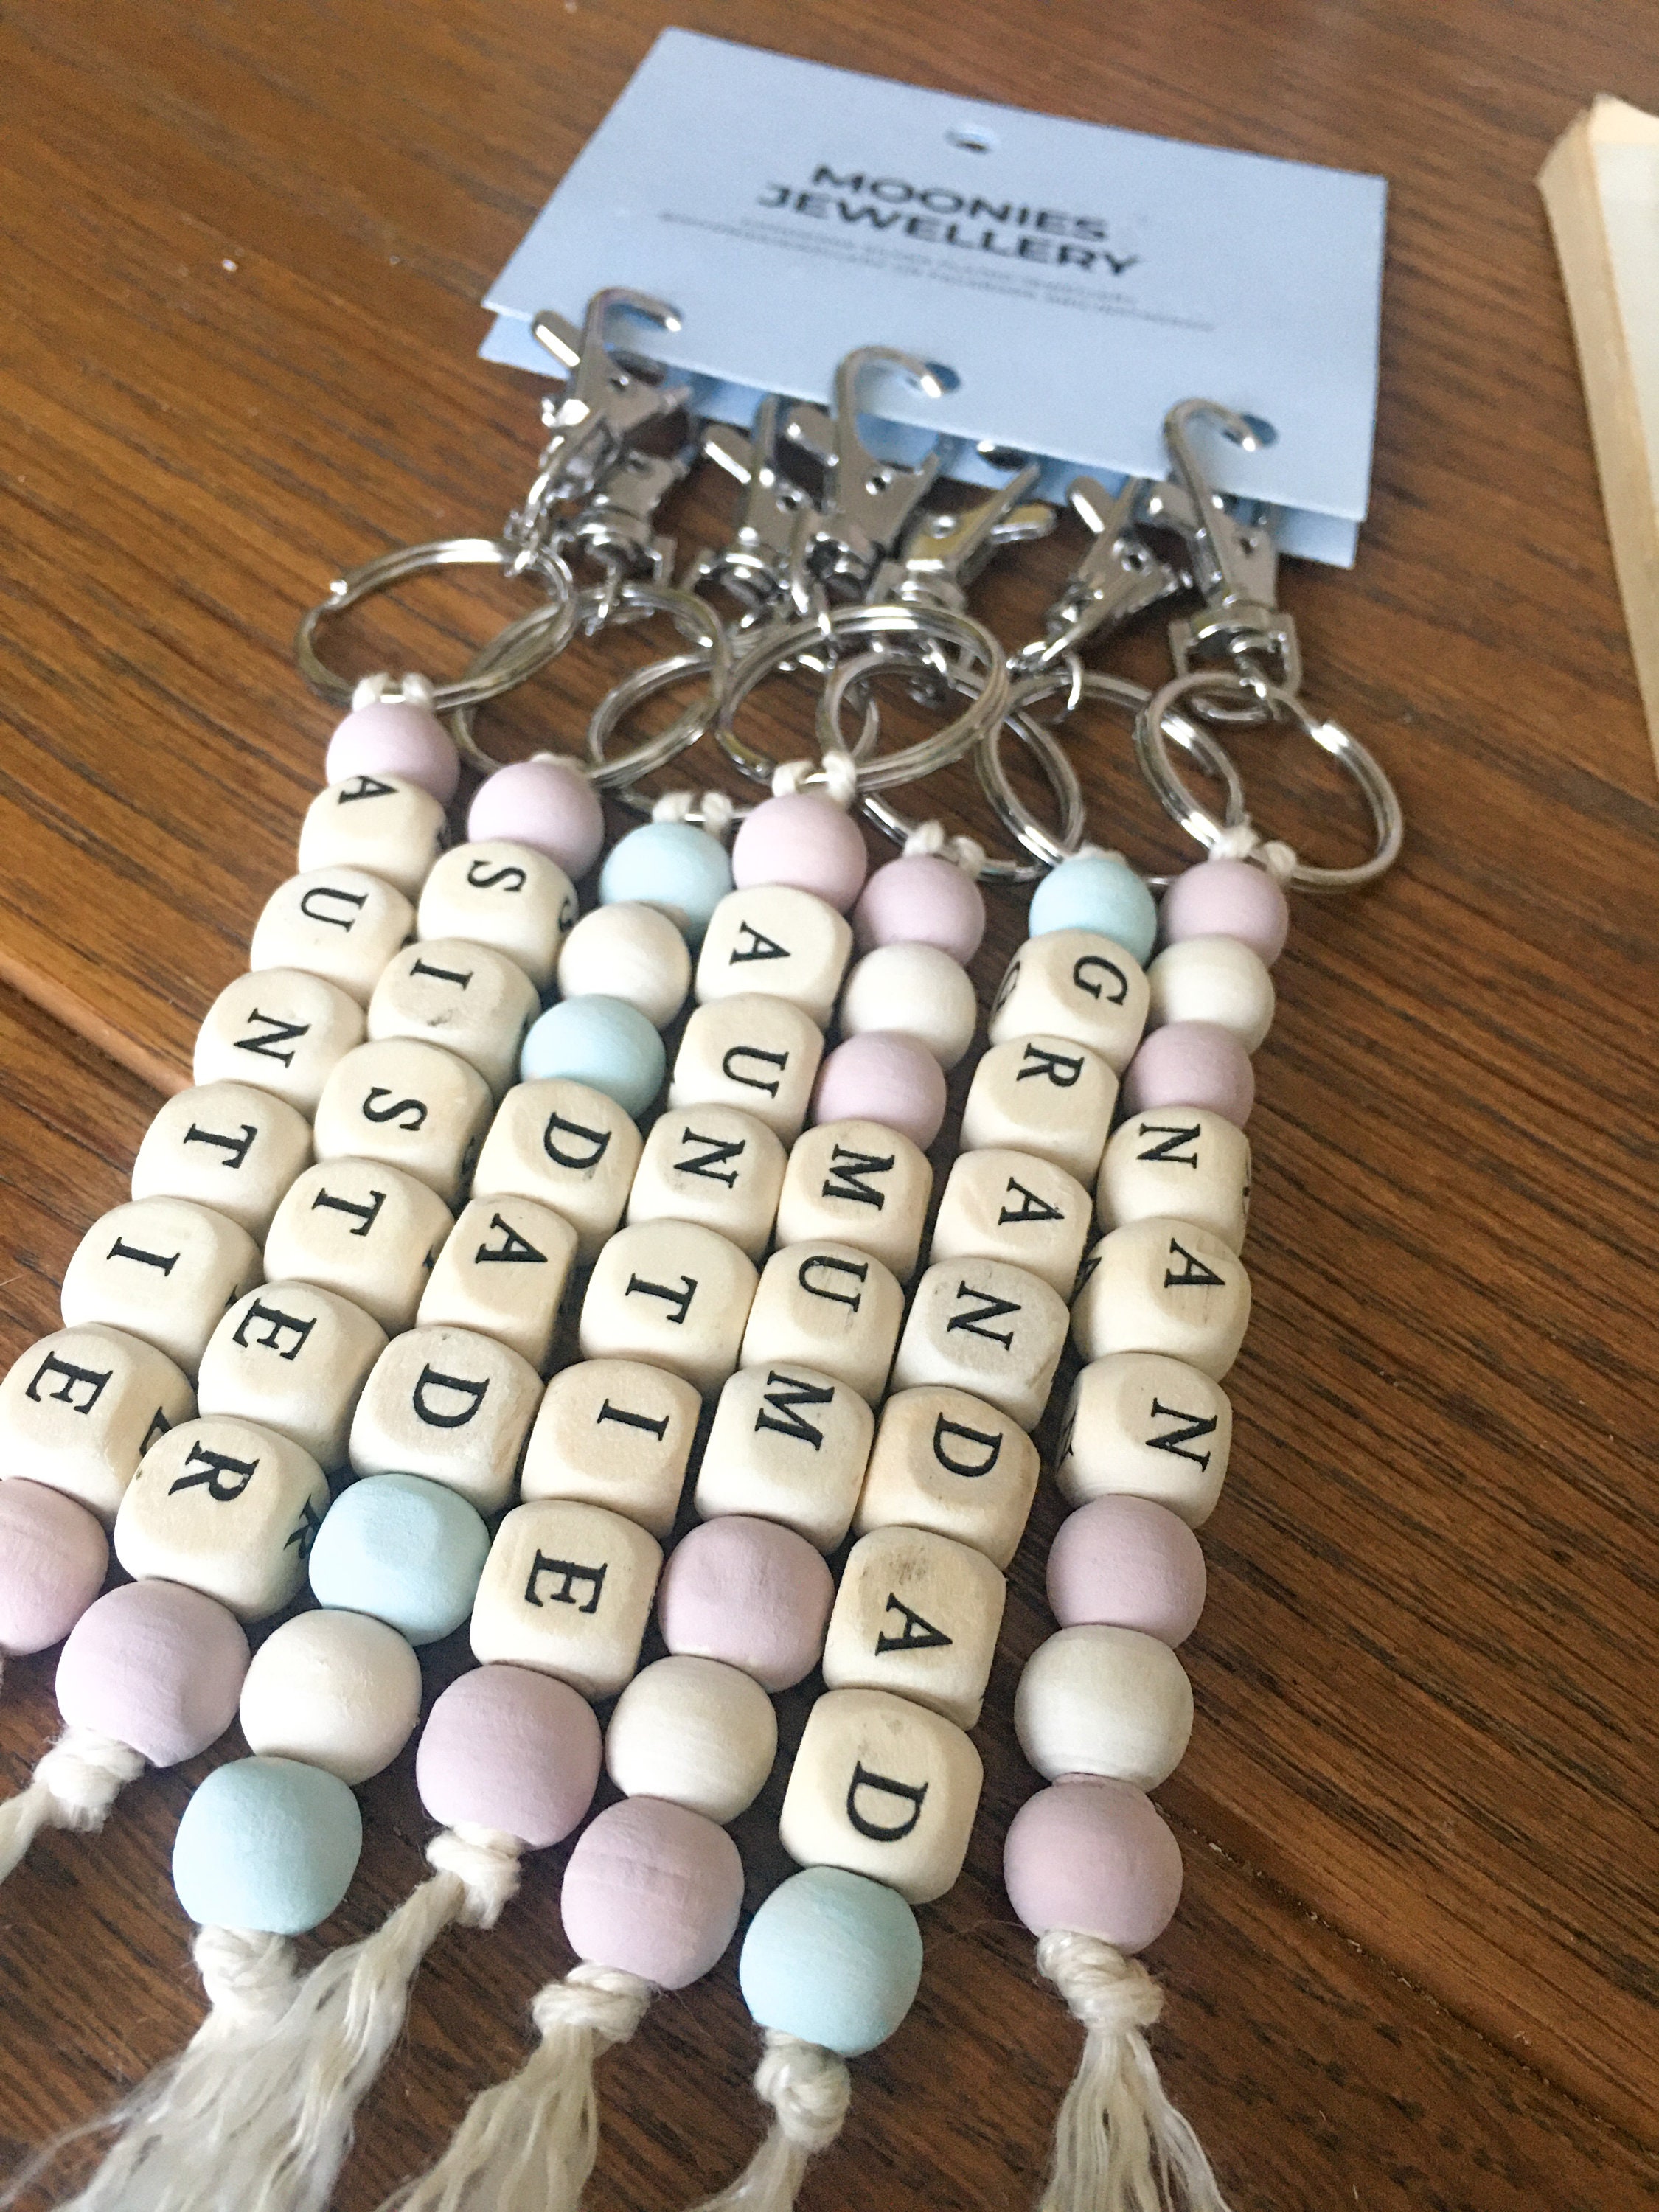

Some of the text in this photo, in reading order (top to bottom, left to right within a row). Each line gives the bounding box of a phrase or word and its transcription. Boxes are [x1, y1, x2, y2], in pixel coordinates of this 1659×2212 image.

[757, 183, 1139, 275] JEWELLERY
[813, 164, 1108, 240] MOONIES
[25, 776, 397, 1415] AUNTIE
[168, 860, 526, 1501] SISTER
[413, 1111, 612, 1427] DAD
[525, 921, 790, 1614] AUNTIE
[754, 1144, 894, 1450] MUM
[846, 956, 1130, 1841] GRANDAD
[1138, 1123, 1225, 1472] NAN
